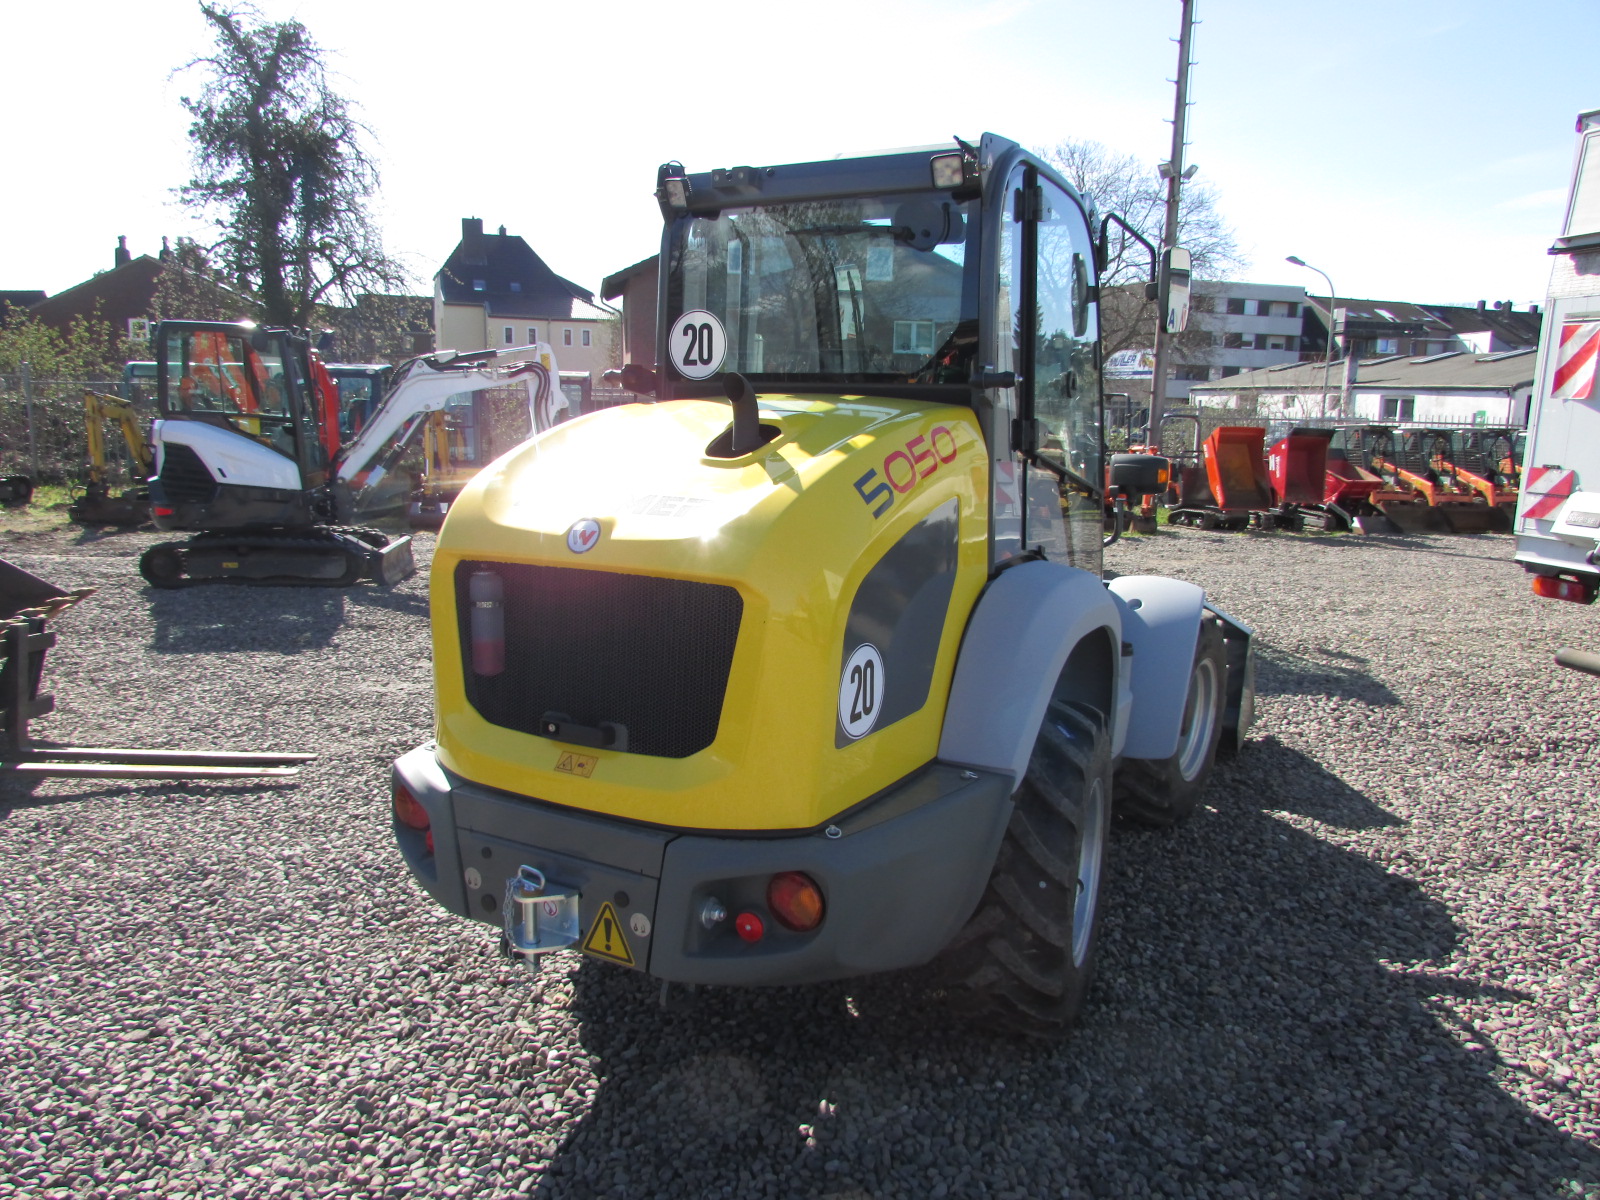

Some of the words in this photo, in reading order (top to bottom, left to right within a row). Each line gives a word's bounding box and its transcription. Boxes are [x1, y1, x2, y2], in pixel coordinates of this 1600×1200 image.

[683, 323, 713, 366] 20
[853, 426, 957, 520] 5050
[850, 659, 875, 724] 20
